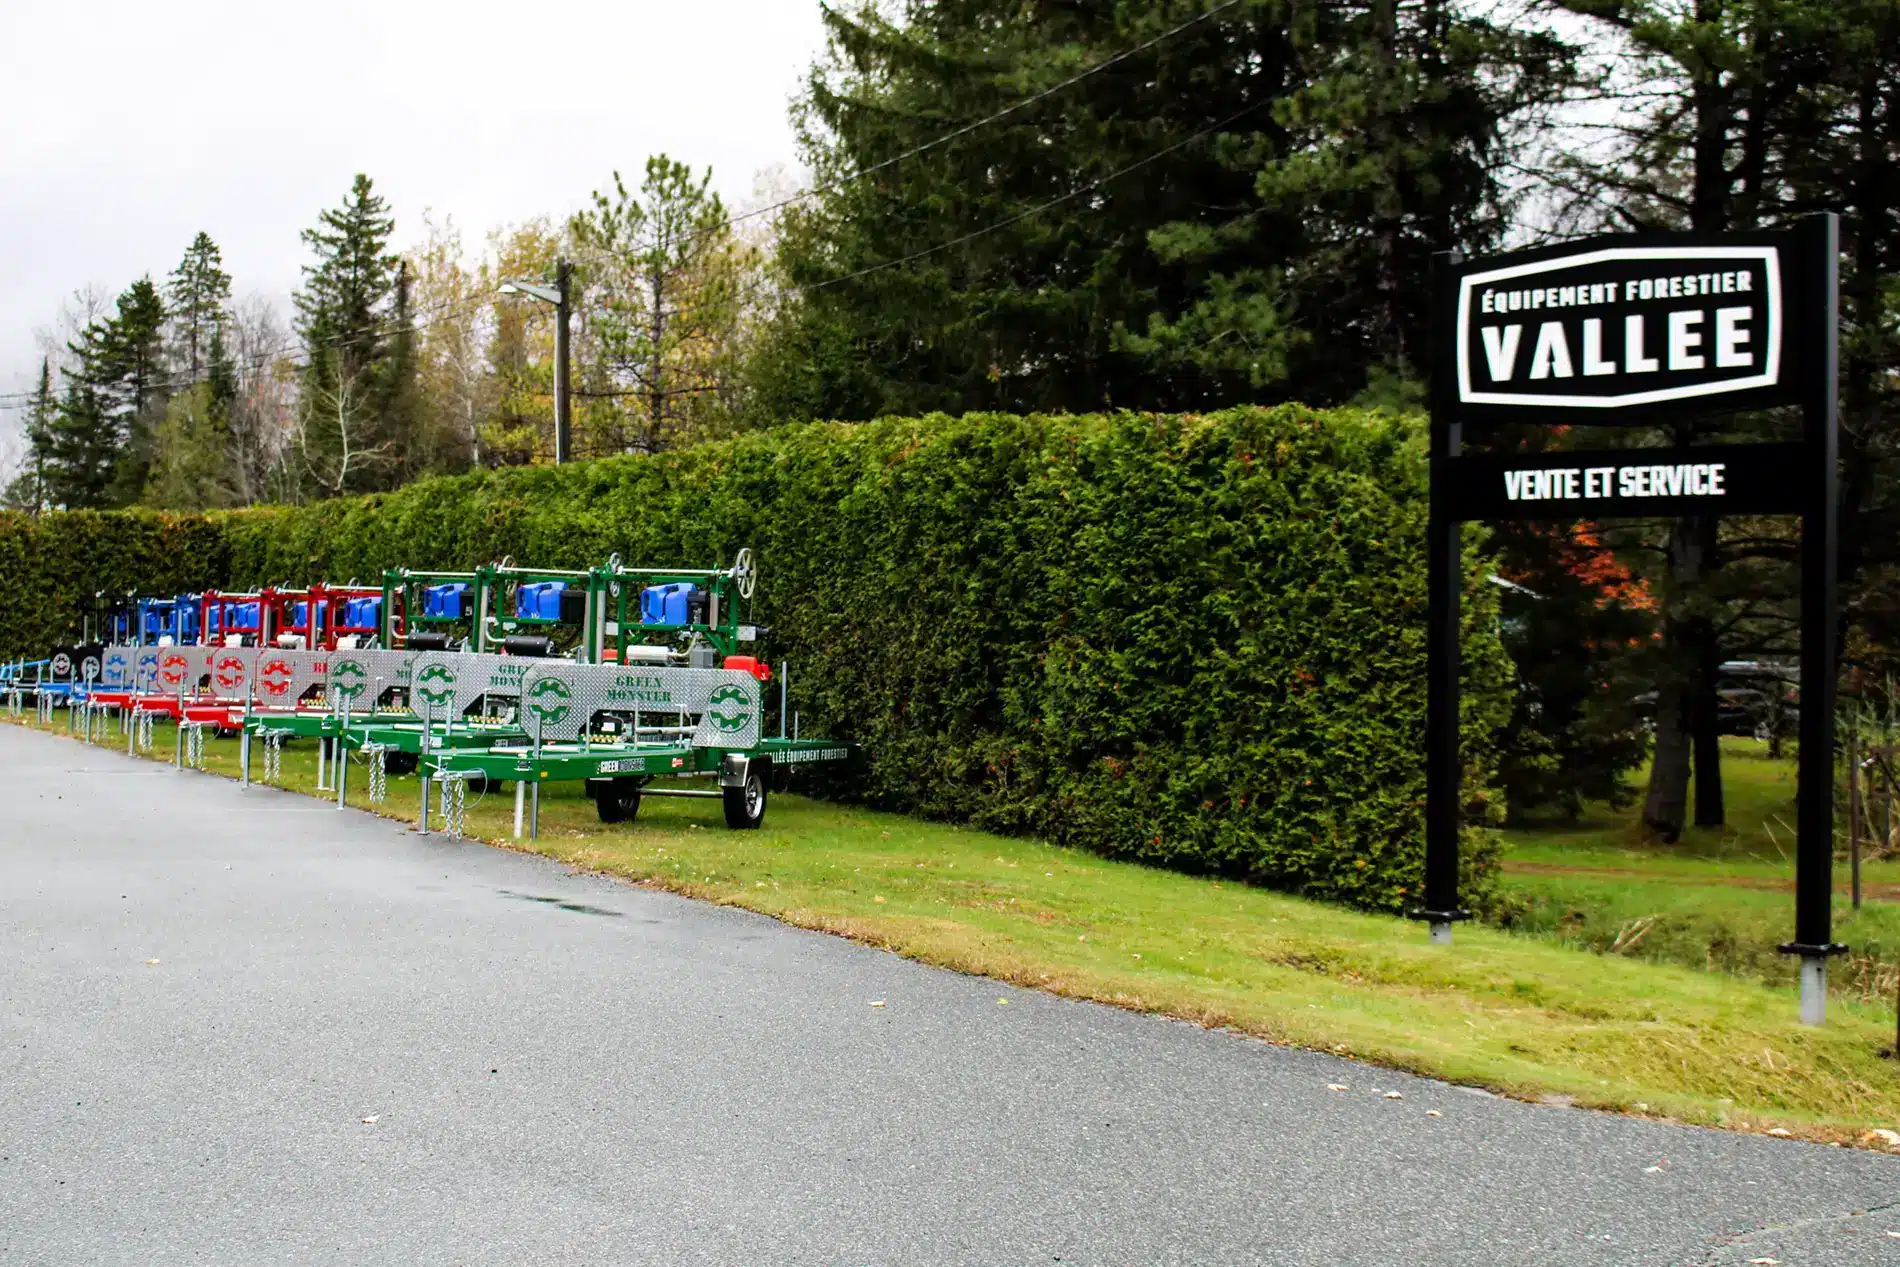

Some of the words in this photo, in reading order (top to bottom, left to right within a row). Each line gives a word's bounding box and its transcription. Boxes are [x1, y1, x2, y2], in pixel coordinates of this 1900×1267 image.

[1481, 282, 1618, 313] ÉQUIPEMENT
[1625, 270, 1752, 301] FORESTIER
[1481, 306, 1753, 381] VALLEE
[1504, 468, 1580, 500] VENTE
[1584, 467, 1615, 498] ET
[1619, 464, 1726, 497] SERVICE
[616, 676, 662, 687] GREEN
[607, 690, 671, 702] MONSTER
[787, 749, 820, 762] ÉQUIPEMENT
[821, 748, 848, 760] FORESTIER
[600, 760, 619, 773] GREEN
